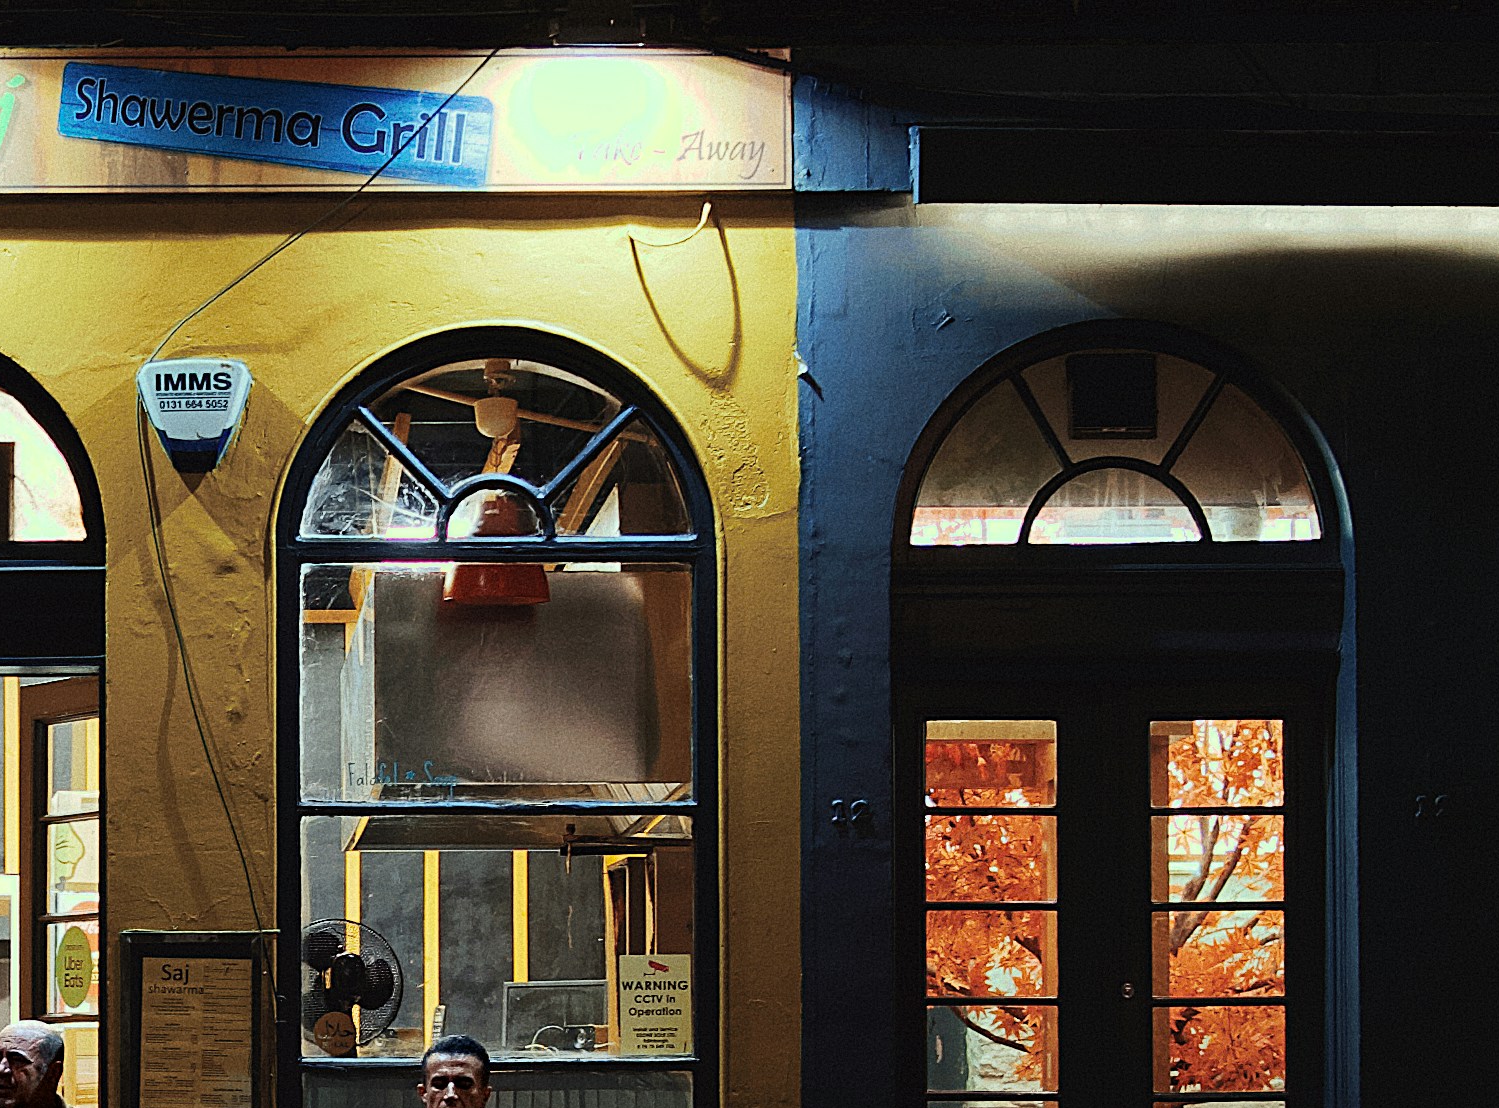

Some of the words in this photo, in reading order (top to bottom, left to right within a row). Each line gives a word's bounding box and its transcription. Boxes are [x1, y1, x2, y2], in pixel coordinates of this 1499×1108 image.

[76, 76, 320, 148] Shawerma
[341, 102, 470, 166] Grill
[676, 130, 768, 181] Away
[155, 372, 233, 392] IMMS
[159, 399, 183, 410] 0131
[205, 398, 229, 409] 5052
[64, 955, 84, 971] Uber
[63, 972, 84, 988] Eats
[160, 963, 190, 985] Saj
[148, 983, 205, 995] shawarma
[621, 980, 689, 991] WARNING
[634, 994, 663, 1004] CCTV
[666, 994, 676, 1003] in
[628, 1006, 682, 1018] Operation
